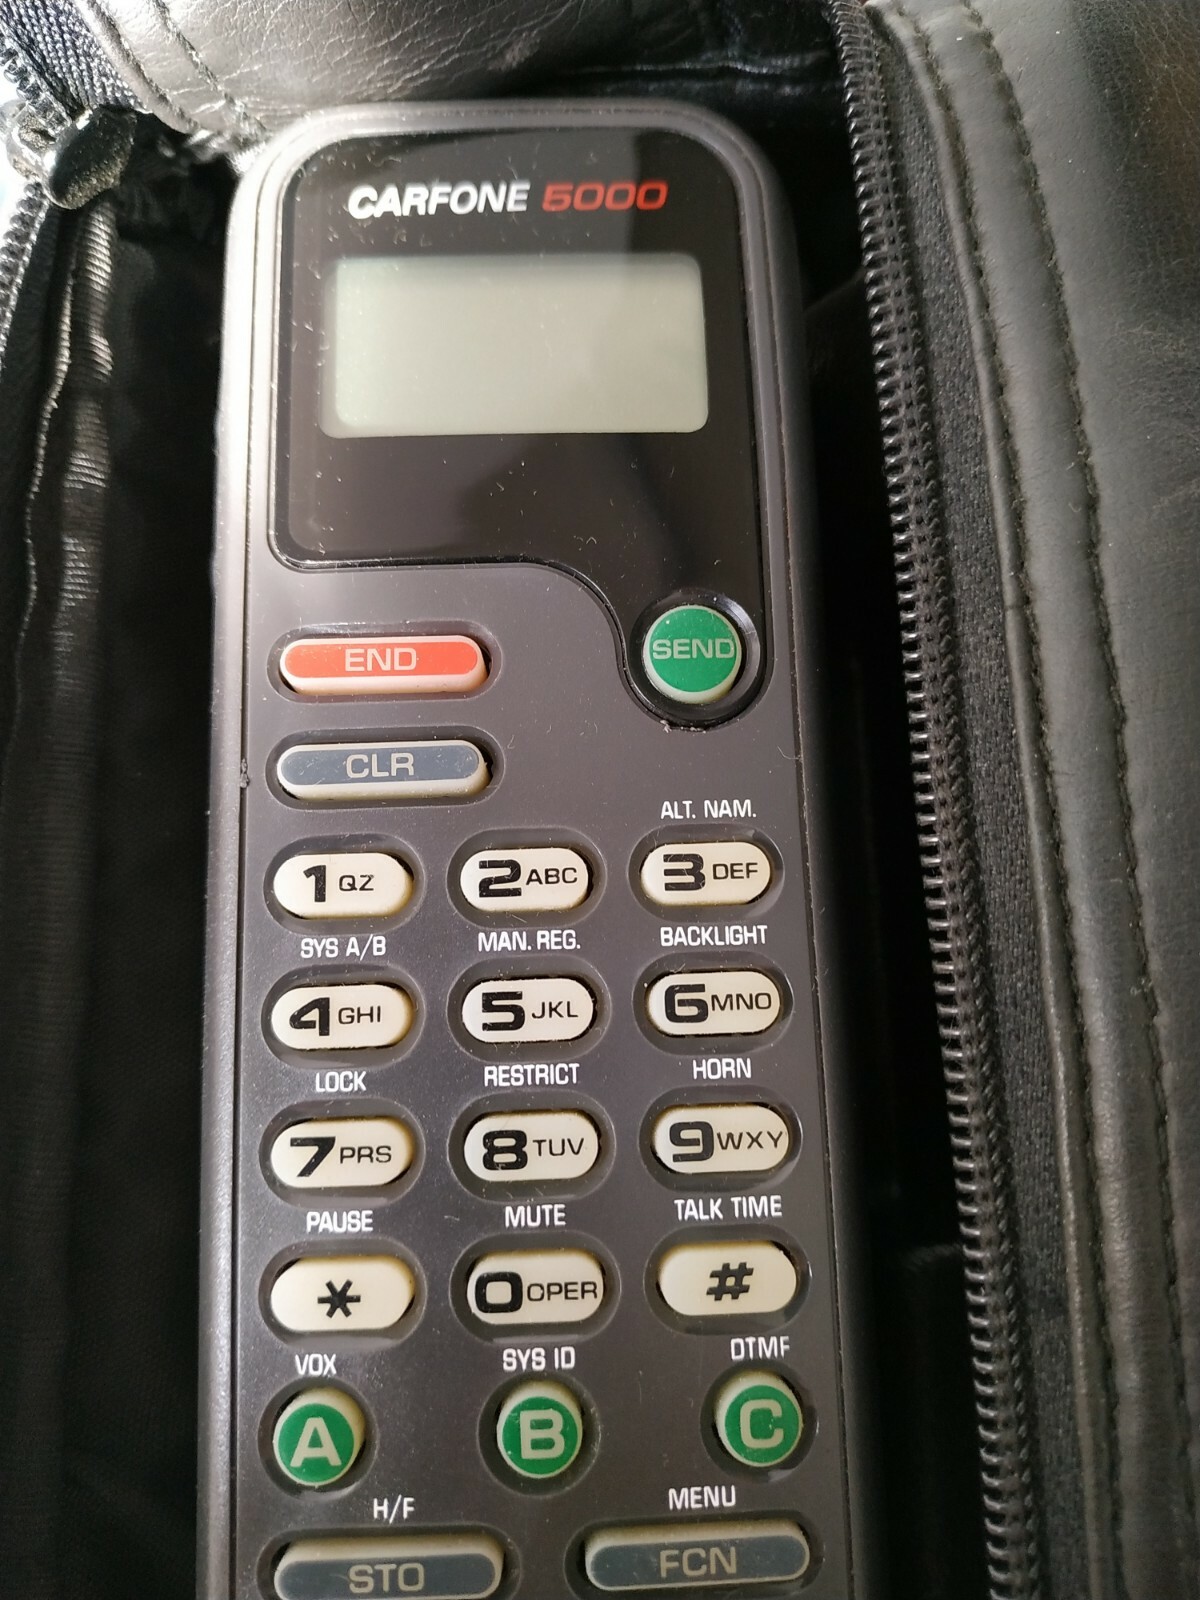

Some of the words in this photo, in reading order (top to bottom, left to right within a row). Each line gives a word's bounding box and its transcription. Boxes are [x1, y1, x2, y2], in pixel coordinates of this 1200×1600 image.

[347, 180, 531, 220] CARFONE
[541, 180, 669, 212] 5000
[344, 648, 417, 672] END
[651, 638, 736, 661] SEND
[346, 754, 415, 777] CLR
[660, 801, 697, 820] ALT.
[703, 800, 758, 819] NAM.
[303, 865, 327, 903] 1
[338, 874, 375, 892] QZ
[478, 859, 523, 897] 2
[526, 868, 578, 884] ABC
[662, 853, 706, 891] 3
[712, 863, 759, 880] DEF
[299, 938, 339, 959] SYS
[346, 936, 387, 962] A/B
[477, 932, 533, 952] MAN.
[536, 931, 581, 950] REG.
[659, 926, 767, 948] BACKLIGHT
[289, 997, 331, 1036] 4
[337, 1006, 382, 1025] GHI
[481, 991, 526, 1032] 5
[531, 1000, 579, 1020] JKL
[663, 984, 709, 1024] 6
[710, 992, 772, 1011] MNO
[483, 1064, 580, 1088] RESTRICT
[692, 1059, 752, 1079] HORN
[315, 1072, 367, 1092] LOCK
[481, 1129, 528, 1170] 8
[532, 1137, 584, 1157] TUV
[669, 1121, 715, 1162] 9
[716, 1130, 787, 1151] WXY
[289, 1136, 336, 1178] 7
[339, 1146, 392, 1163] PRS
[504, 1205, 566, 1227] MUTE
[674, 1198, 723, 1221] TALK
[729, 1195, 783, 1217] TIME
[306, 1211, 374, 1233] PAUSE
[526, 1281, 598, 1302] OPER
[502, 1349, 548, 1371] SYS
[553, 1347, 576, 1369] ID
[730, 1337, 791, 1359] DTMF
[295, 1355, 337, 1376] VOX
[519, 1410, 566, 1461] B
[739, 1400, 784, 1448] C
[289, 1418, 341, 1467] A
[373, 1498, 415, 1523] H/F
[668, 1488, 737, 1510] MENU
[659, 1547, 737, 1577] FCN
[349, 1563, 425, 1592] STO
